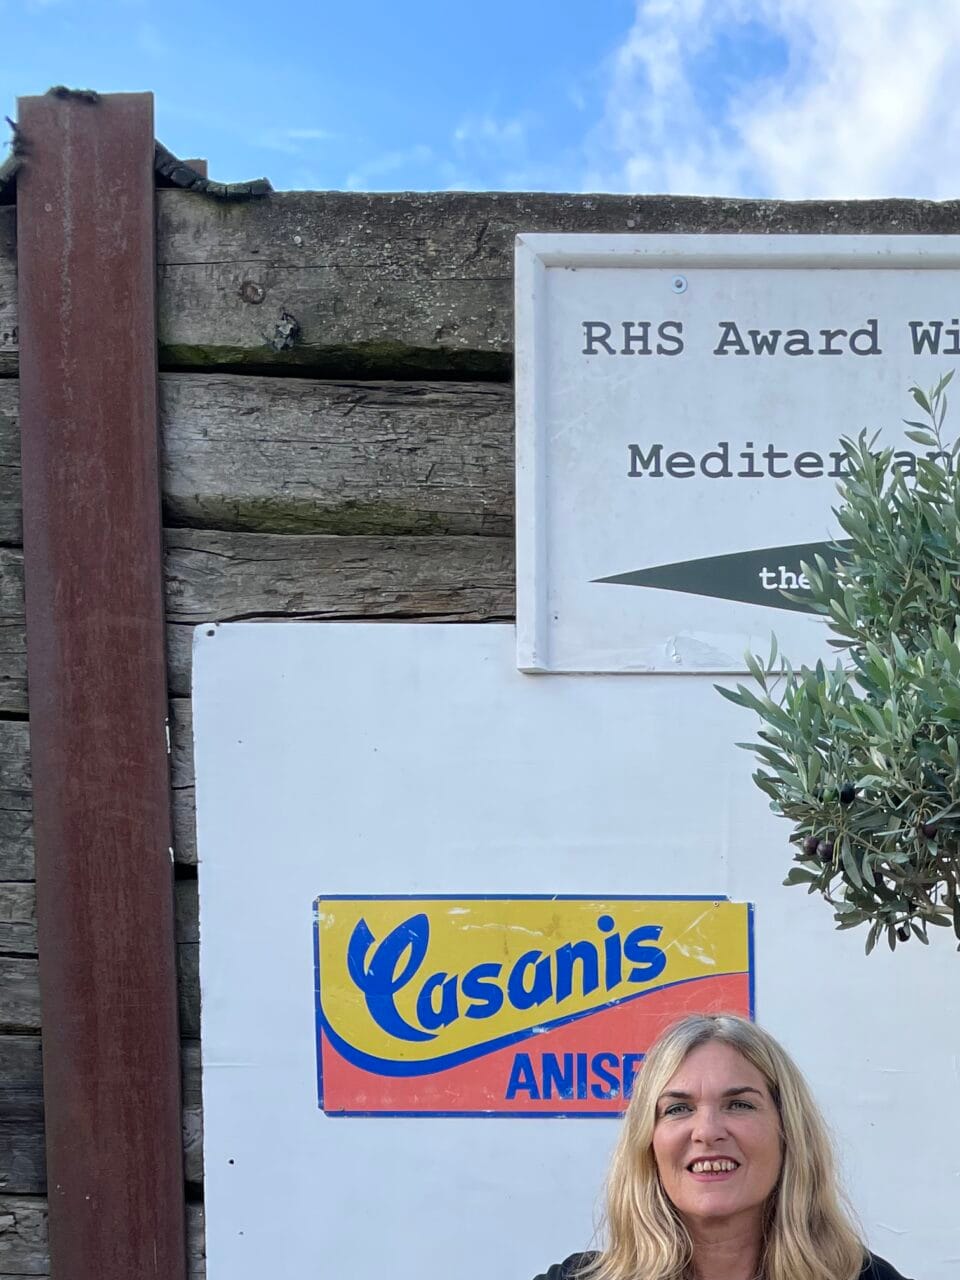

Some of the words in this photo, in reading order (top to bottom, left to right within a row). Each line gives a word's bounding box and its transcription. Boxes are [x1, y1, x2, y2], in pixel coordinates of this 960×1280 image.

[582, 320, 685, 357] RHS
[713, 319, 884, 357] Award
[759, 566, 812, 590] the
[347, 913, 667, 1043] Casanis
